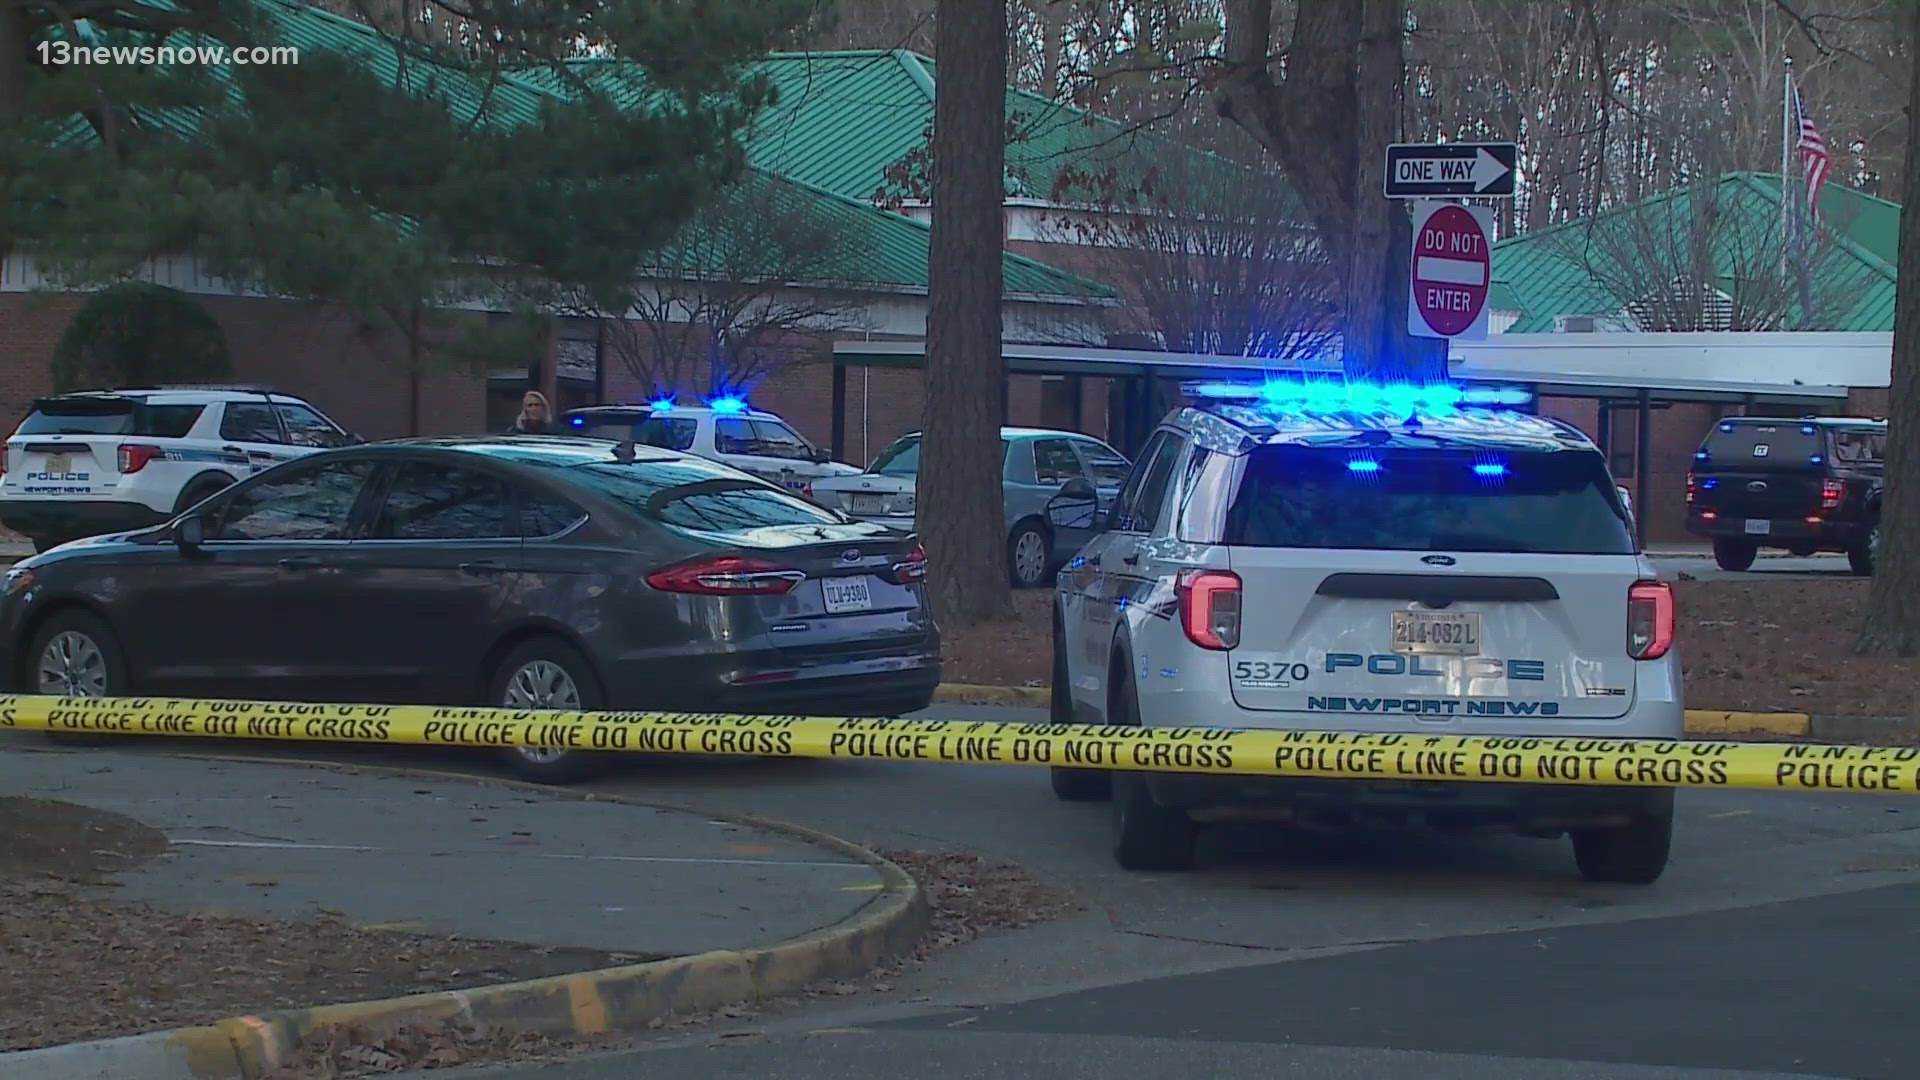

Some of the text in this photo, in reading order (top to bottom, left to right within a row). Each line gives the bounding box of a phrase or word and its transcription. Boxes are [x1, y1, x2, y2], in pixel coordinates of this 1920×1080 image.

[1399, 160, 1476, 180] ONE WAY
[1425, 229, 1481, 255] DO NOT
[1426, 288, 1471, 313] ENTER
[27, 473, 90, 481] POLICE
[1234, 661, 1310, 681] 5370
[1326, 653, 1545, 681] POLICE
[1308, 696, 1560, 715] NEWPORT NEWS
[48, 709, 391, 741] POLICE LINE DO NOT CROSS
[423, 721, 792, 755] POLICE LINE DO NOT CROSS
[829, 732, 1234, 769] POLICE LINE DO NOT CROSS
[1275, 746, 1728, 785] POLICE LINE DO NOT CROSS
[1775, 761, 1902, 790] POLICE
